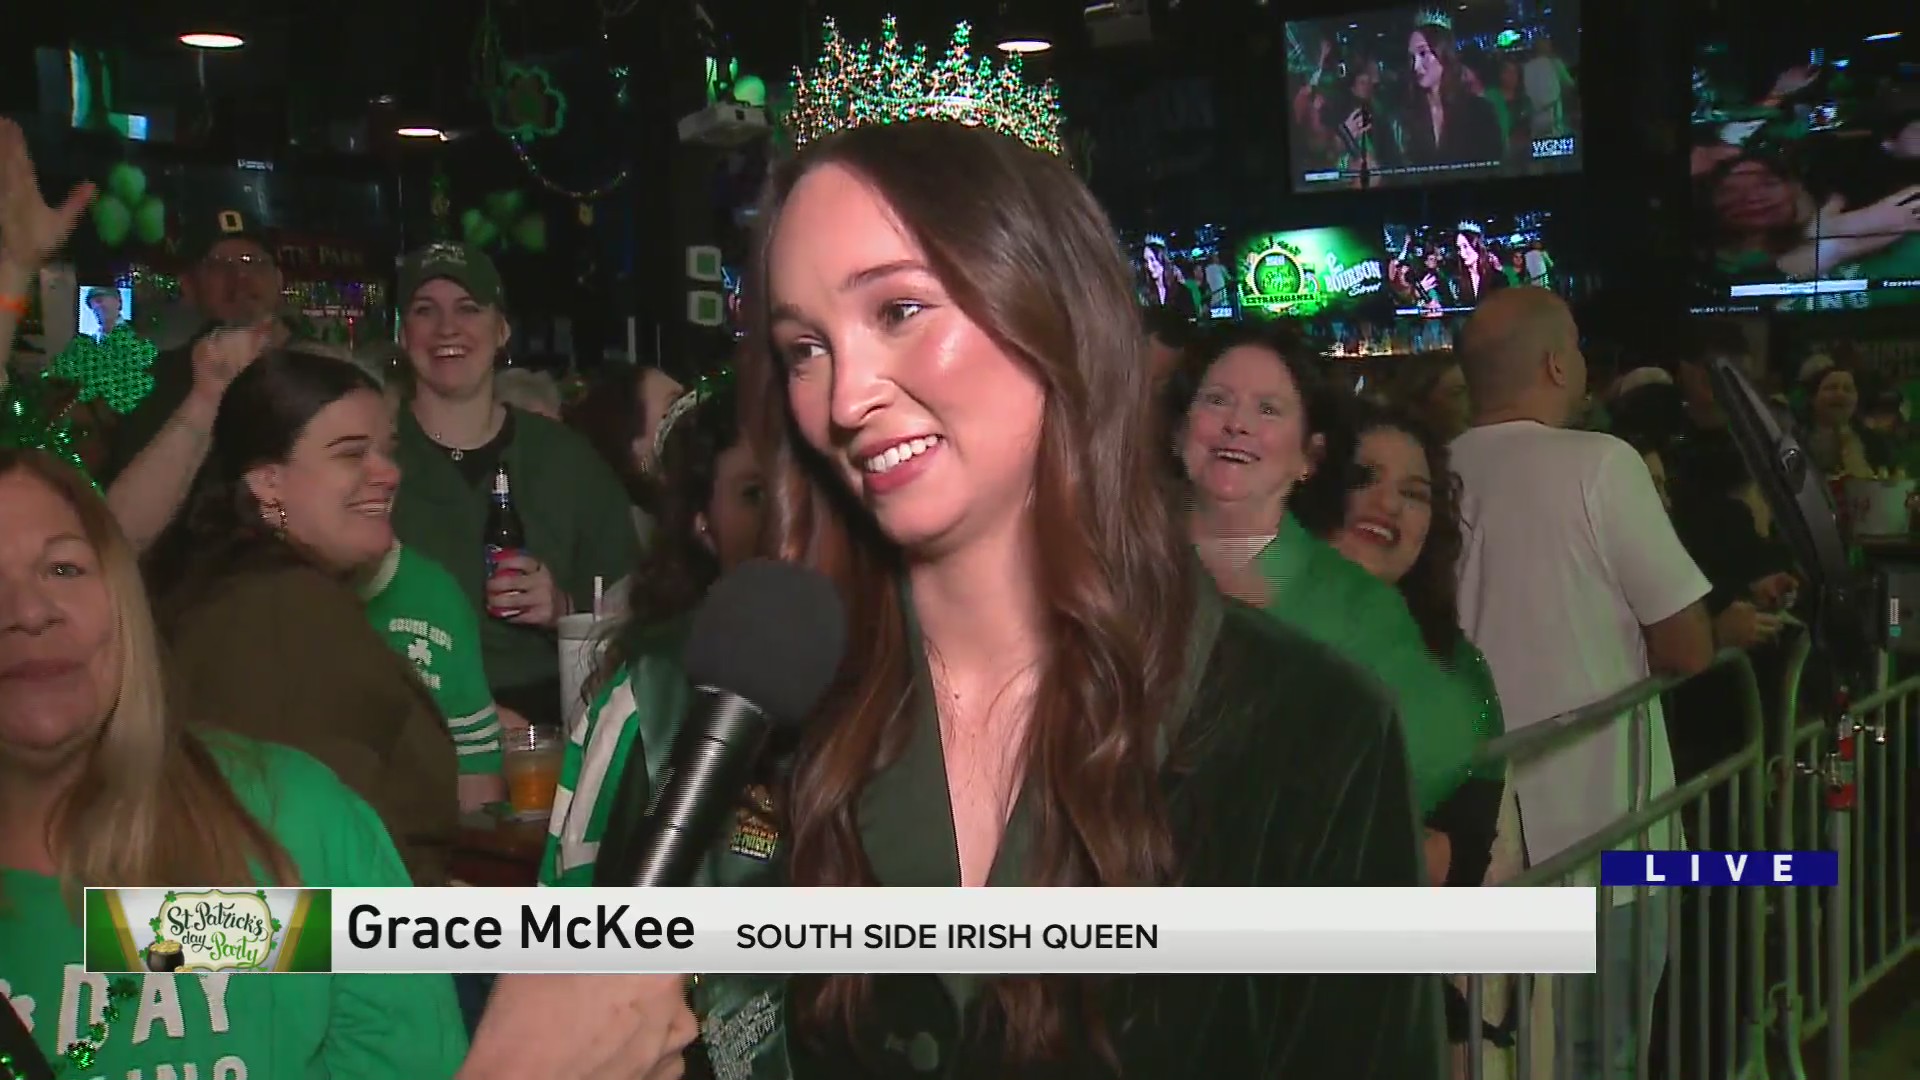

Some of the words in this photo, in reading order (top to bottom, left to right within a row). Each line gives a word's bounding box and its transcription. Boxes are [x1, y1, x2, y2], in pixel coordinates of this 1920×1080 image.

[218, 210, 243, 233] O
[1324, 260, 1382, 293] BOURBON
[1245, 293, 1316, 304] EXTRAVAGANZA
[56, 963, 230, 1055] DAY
